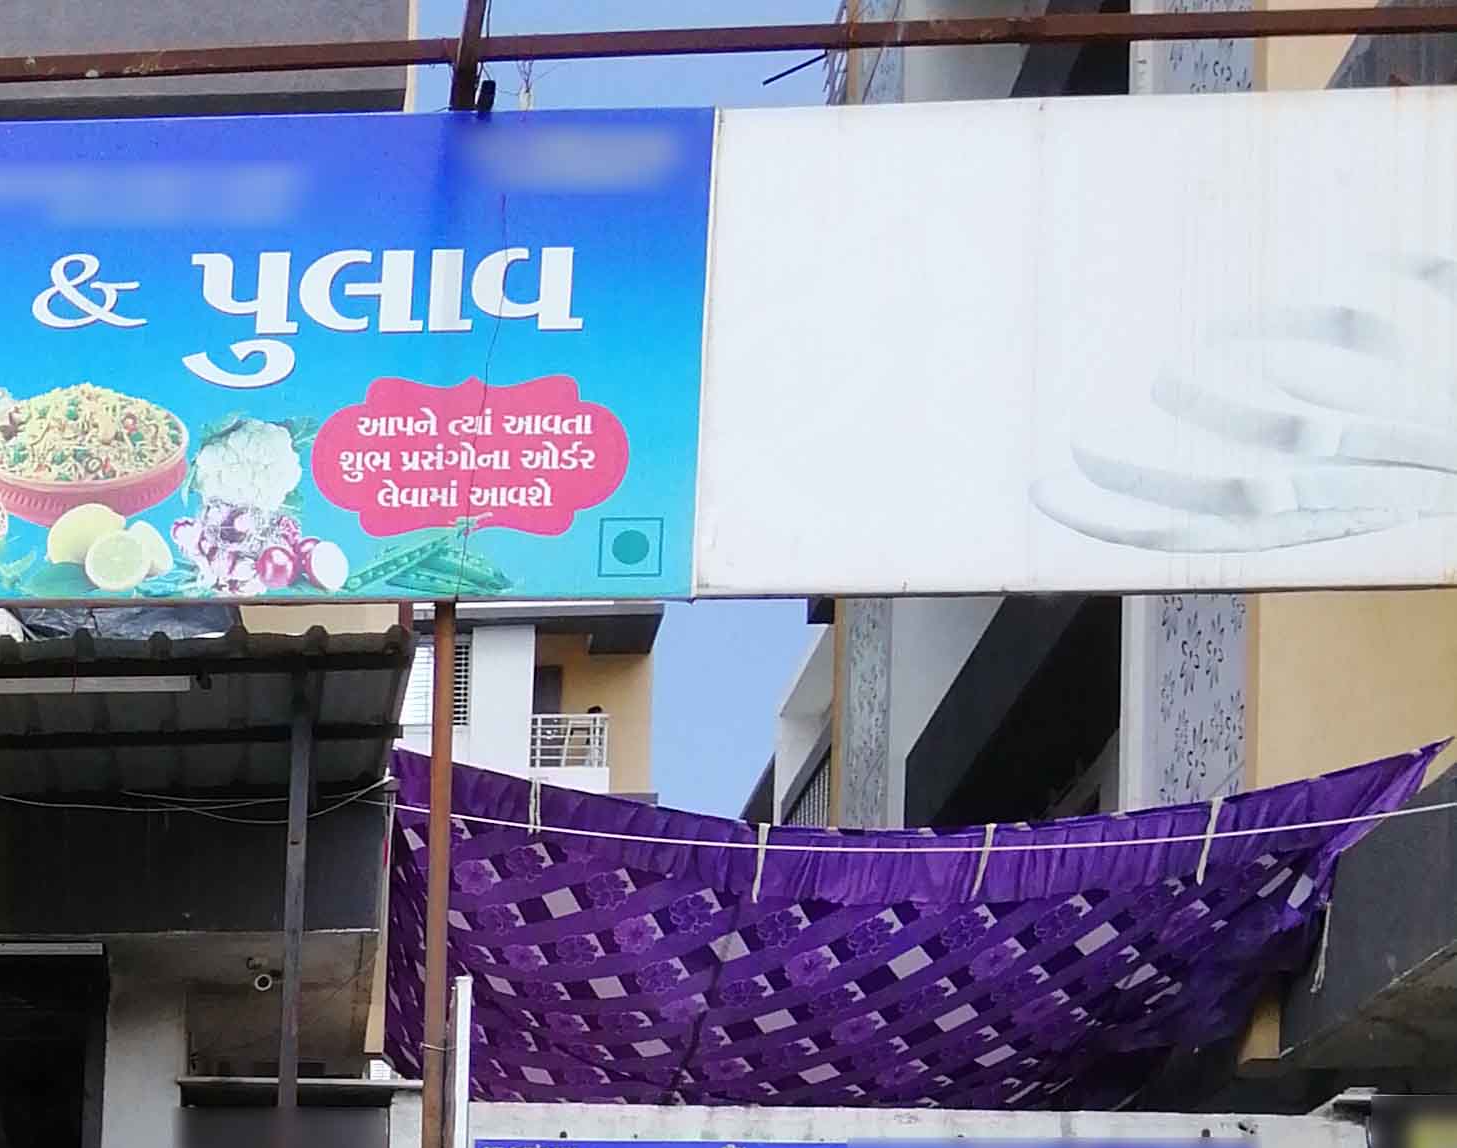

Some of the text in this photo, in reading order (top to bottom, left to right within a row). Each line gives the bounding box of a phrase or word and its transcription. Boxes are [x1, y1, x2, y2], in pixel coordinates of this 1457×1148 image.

[32, 253, 148, 328] &
[182, 246, 584, 389] પુલાવ
[357, 407, 593, 437] આપને ત્યાં આવતા
[338, 441, 596, 483] શુભ પ્રસંગોના ઓર્ડર
[376, 477, 553, 508] લેવામાં આવશે
